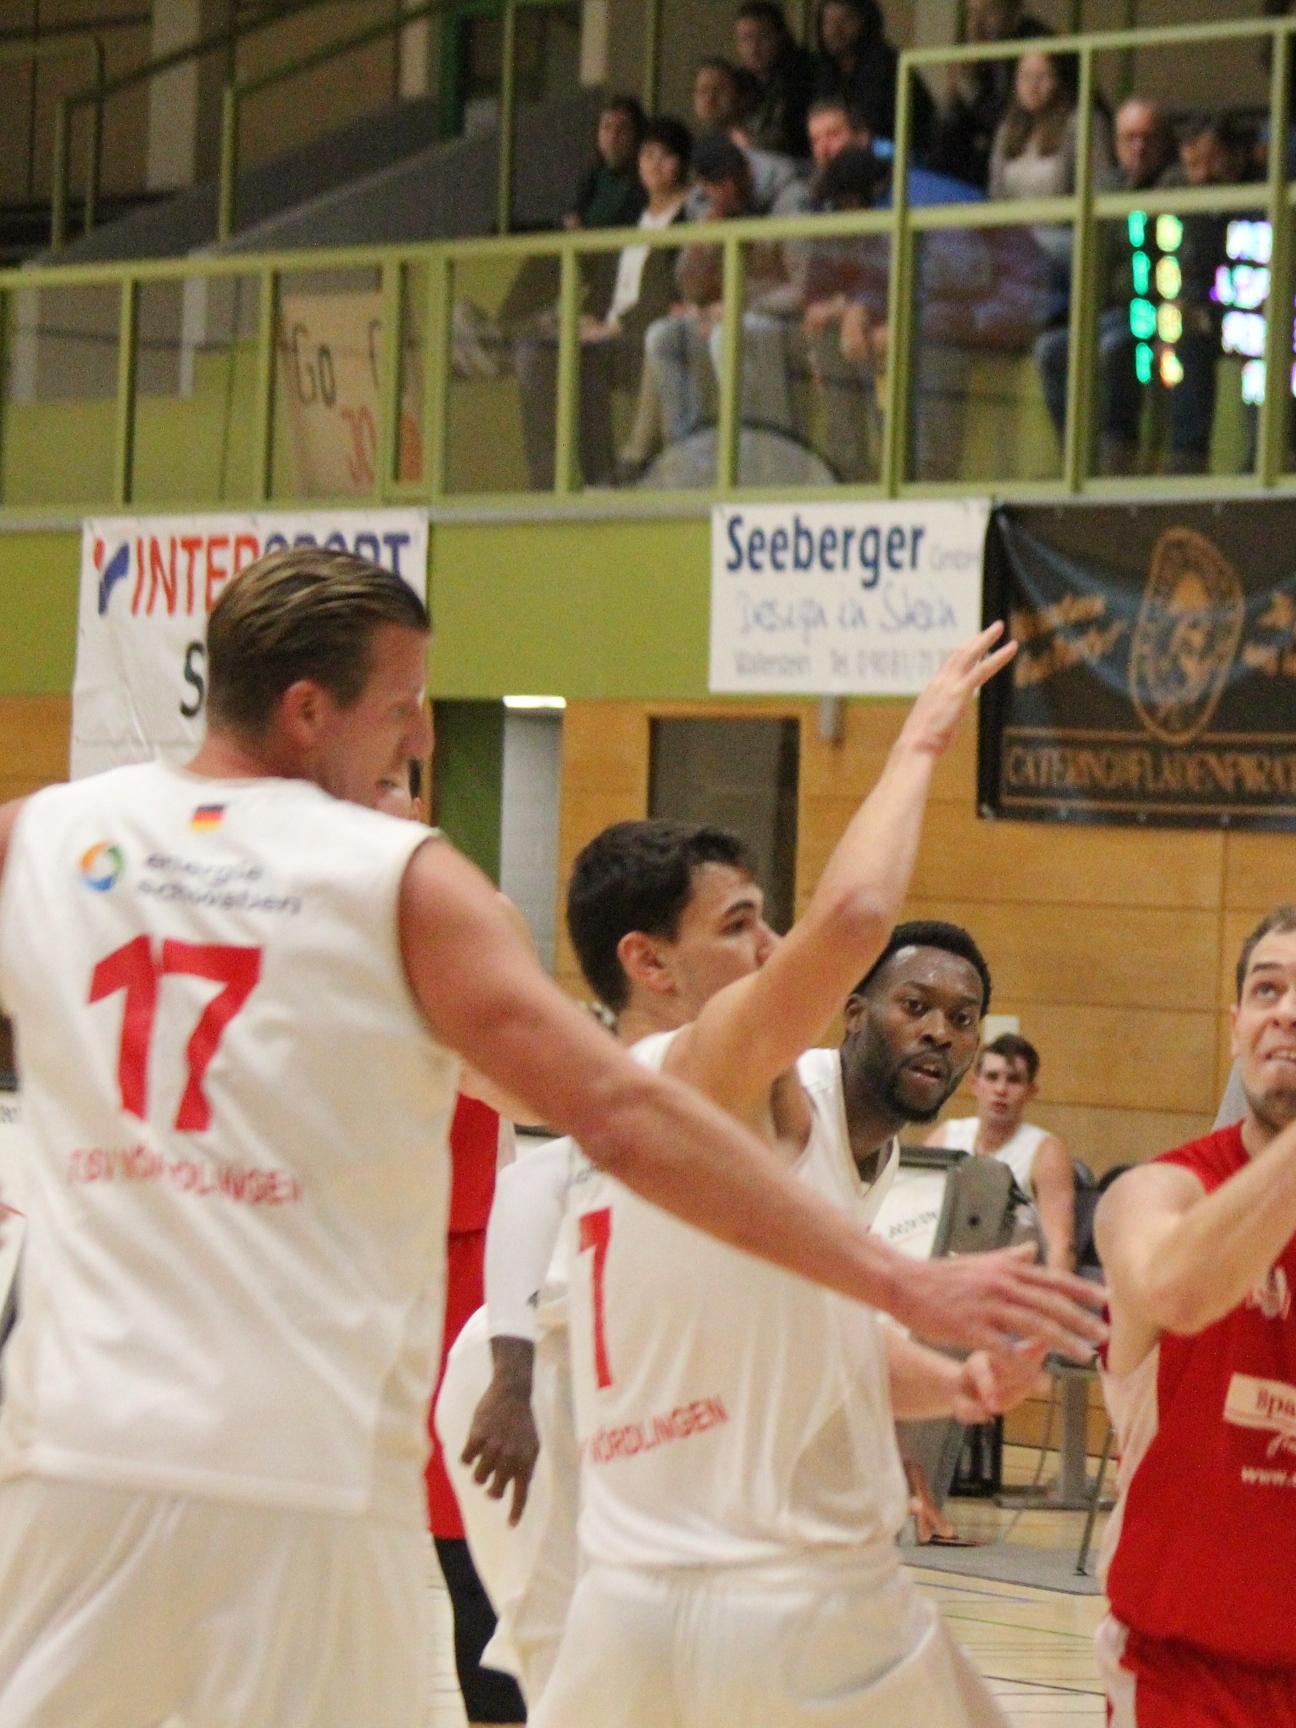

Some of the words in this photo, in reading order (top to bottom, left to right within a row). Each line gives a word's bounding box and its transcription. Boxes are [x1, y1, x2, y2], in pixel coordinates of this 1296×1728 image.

[131, 530, 411, 617] INTERT
[726, 514, 925, 589] Seeberger
[84, 932, 263, 1133] 17
